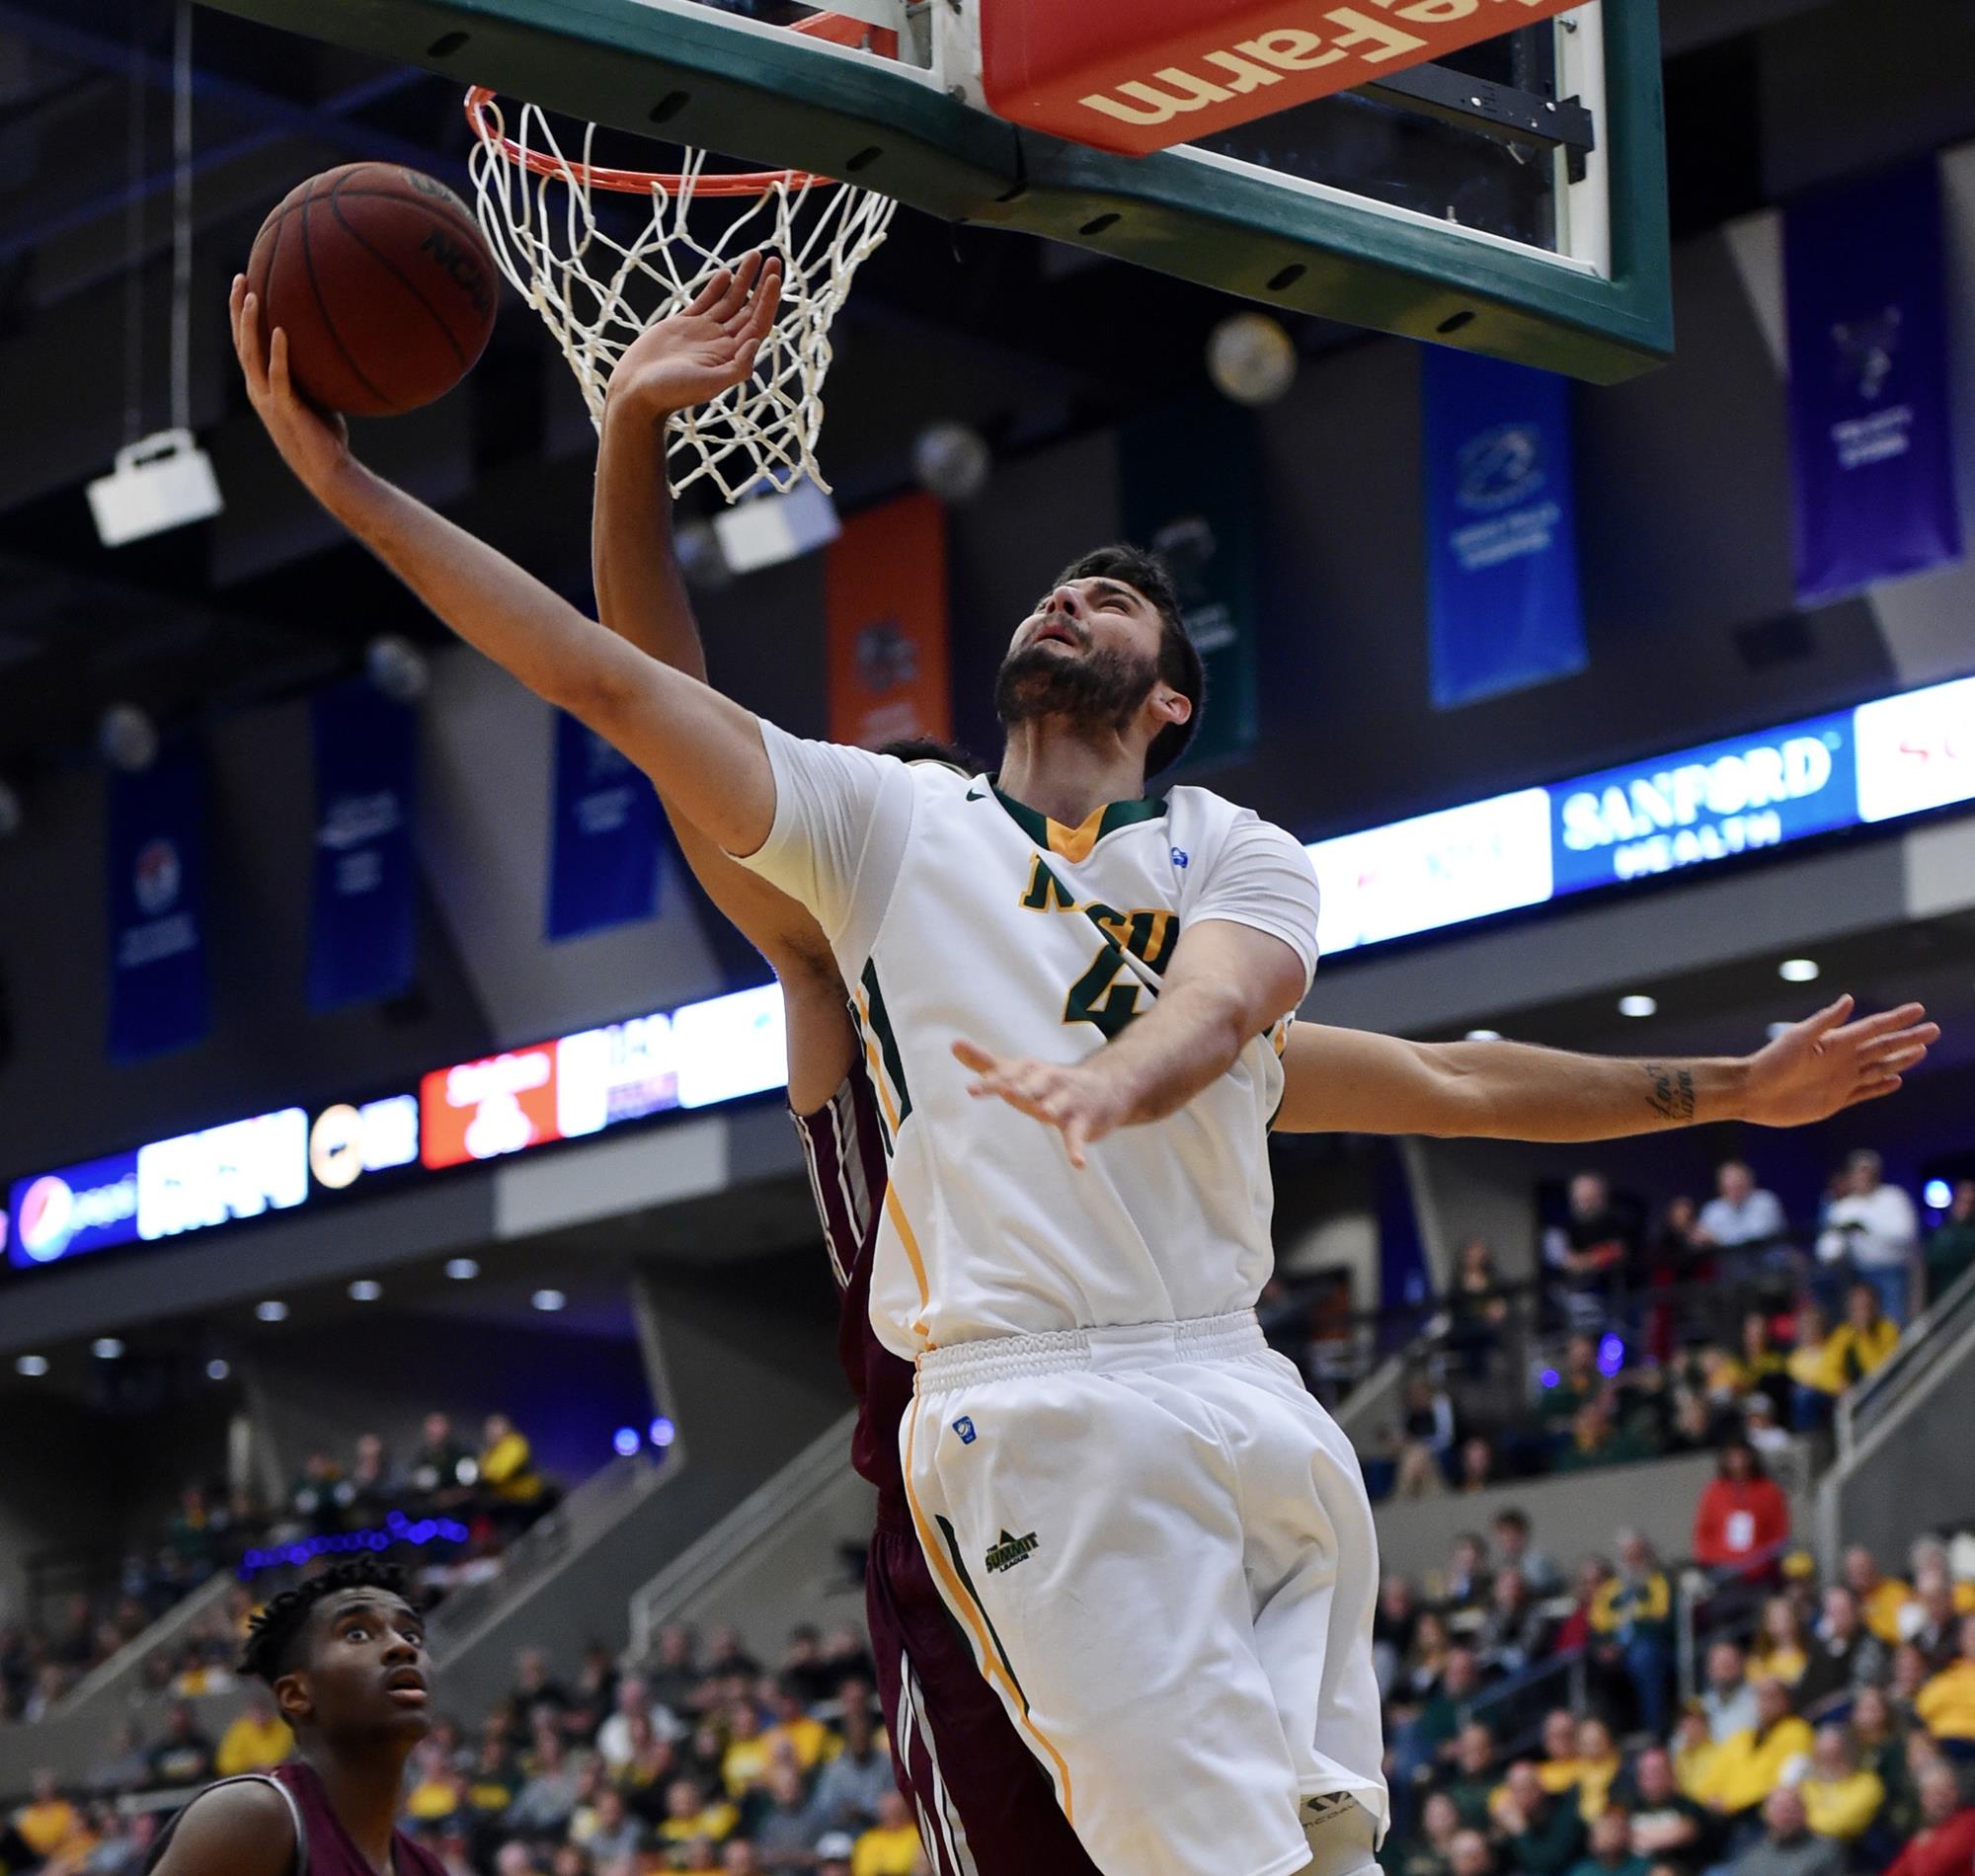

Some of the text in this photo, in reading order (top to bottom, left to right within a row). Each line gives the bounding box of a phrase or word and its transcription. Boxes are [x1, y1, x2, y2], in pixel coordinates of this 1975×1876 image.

[1562, 737, 1832, 850] SANFORD
[1614, 810, 1781, 879] HEALTH
[1062, 942, 1158, 1043] 4
[985, 1531, 1040, 1574] SUMMIT
